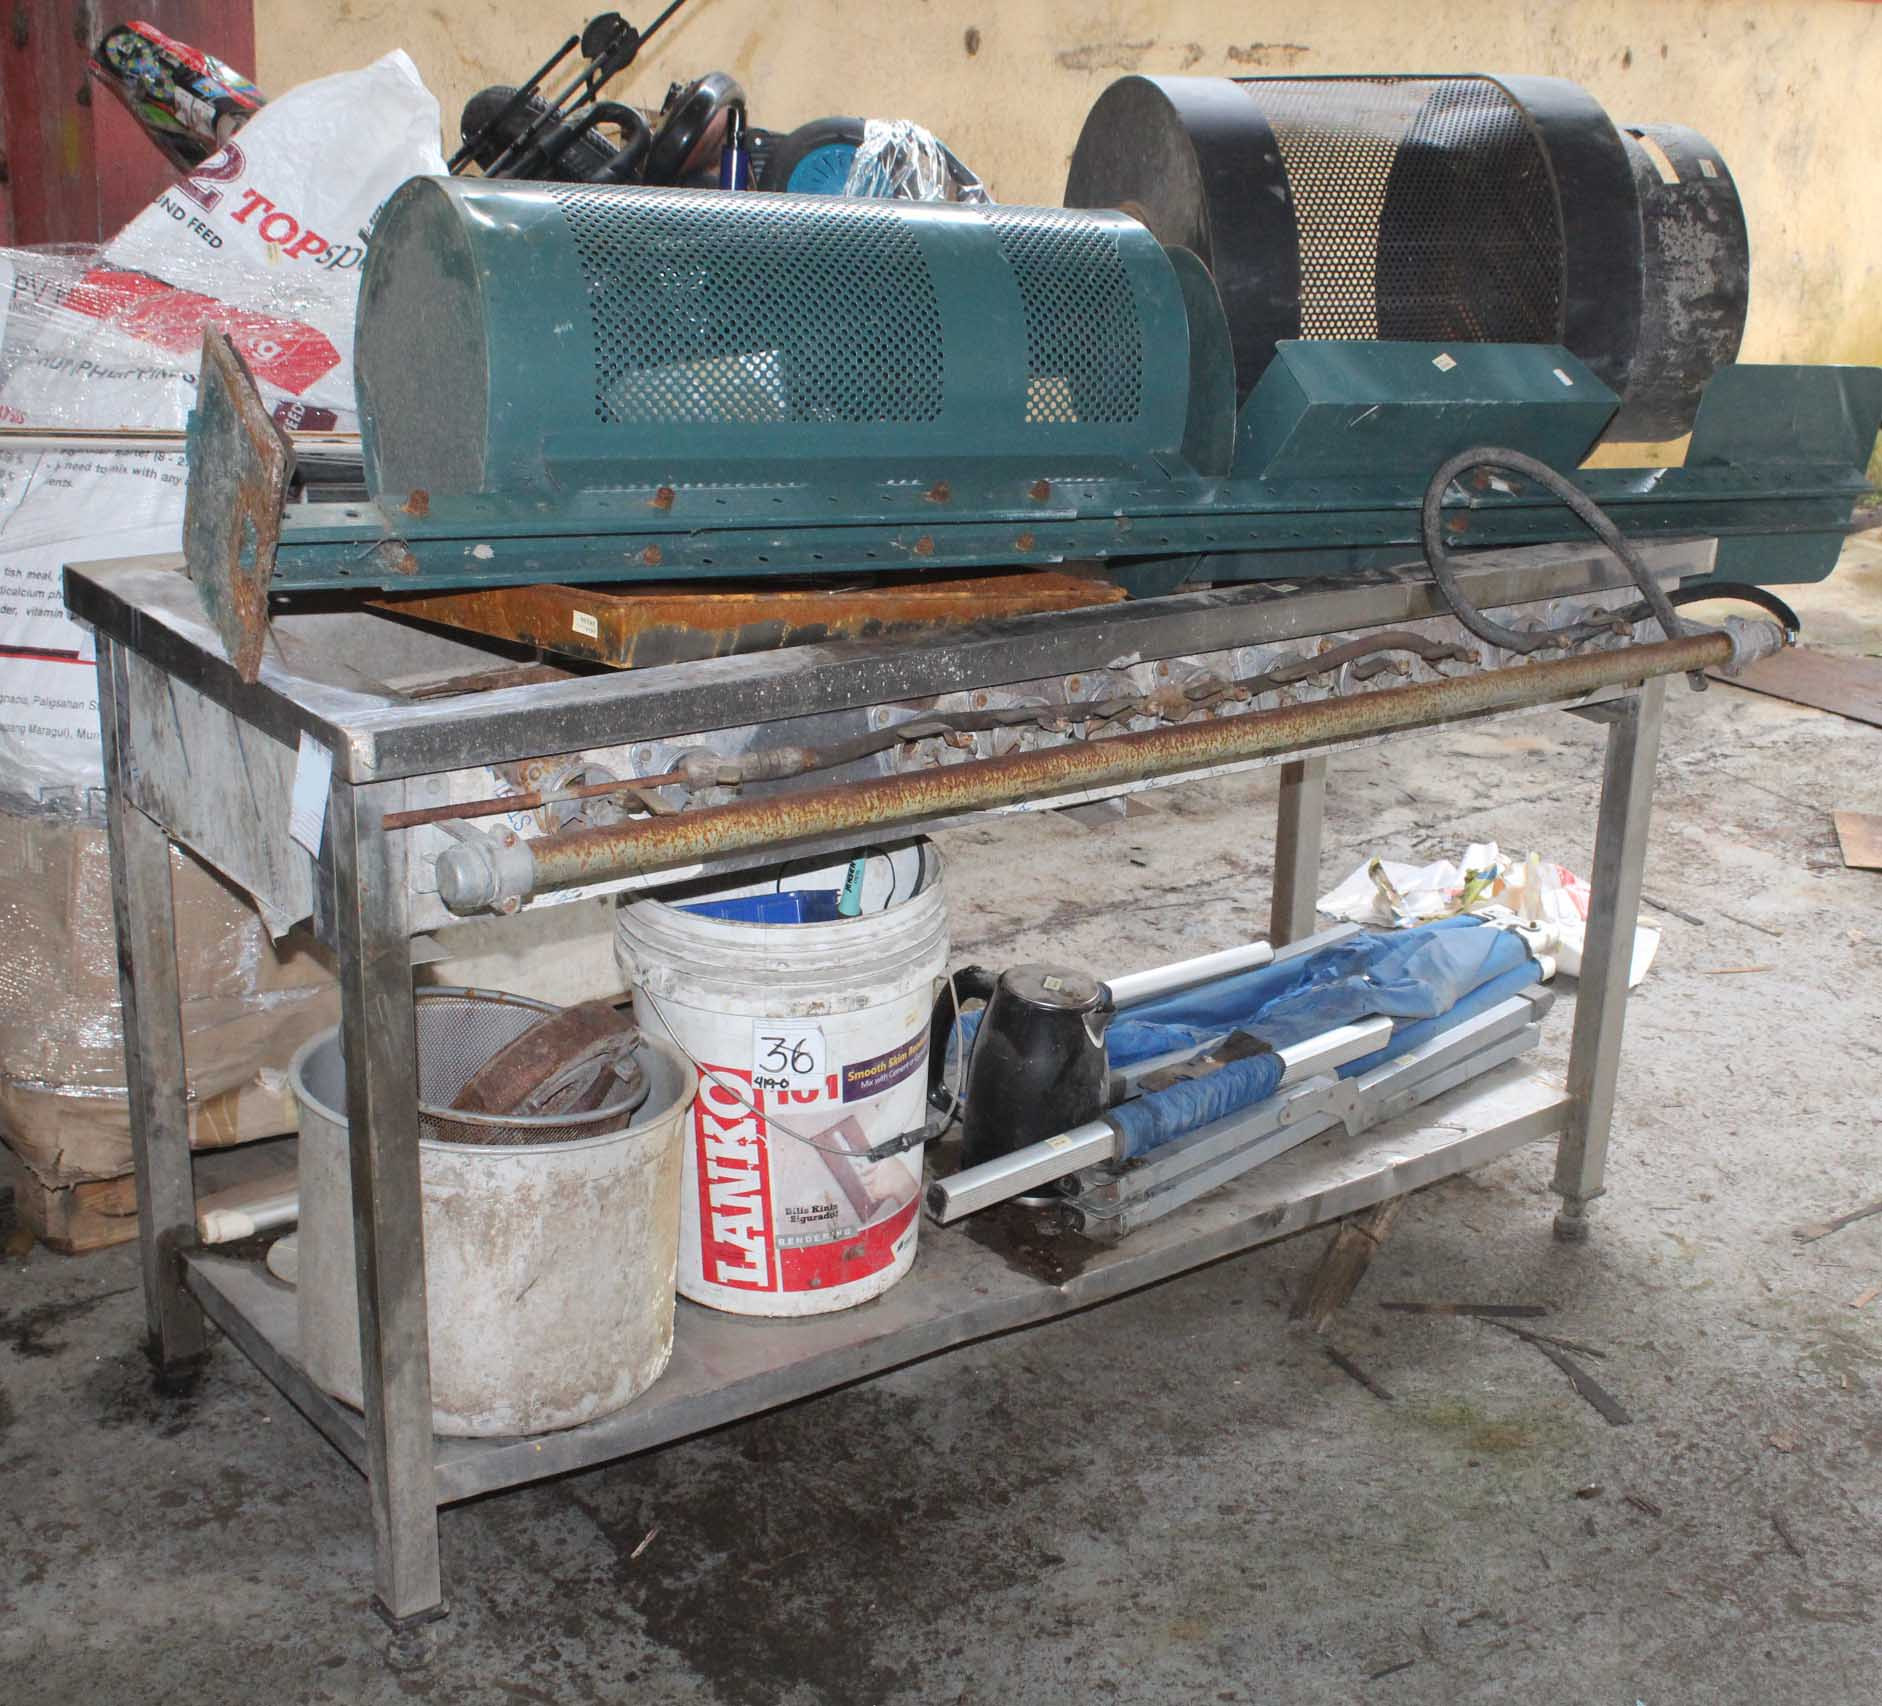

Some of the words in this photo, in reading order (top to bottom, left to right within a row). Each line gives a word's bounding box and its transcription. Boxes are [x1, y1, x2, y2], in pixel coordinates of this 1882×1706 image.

[187, 216, 223, 249] FEED
[64, 461, 91, 472] need
[131, 466, 158, 479] with
[160, 472, 182, 486] any
[759, 1036, 815, 1075] 36
[847, 1061, 887, 1082] Smooth
[888, 1052, 908, 1068] Skim
[860, 1079, 875, 1089] Mix
[874, 1073, 889, 1085] with
[699, 1070, 769, 1287] LANKO
